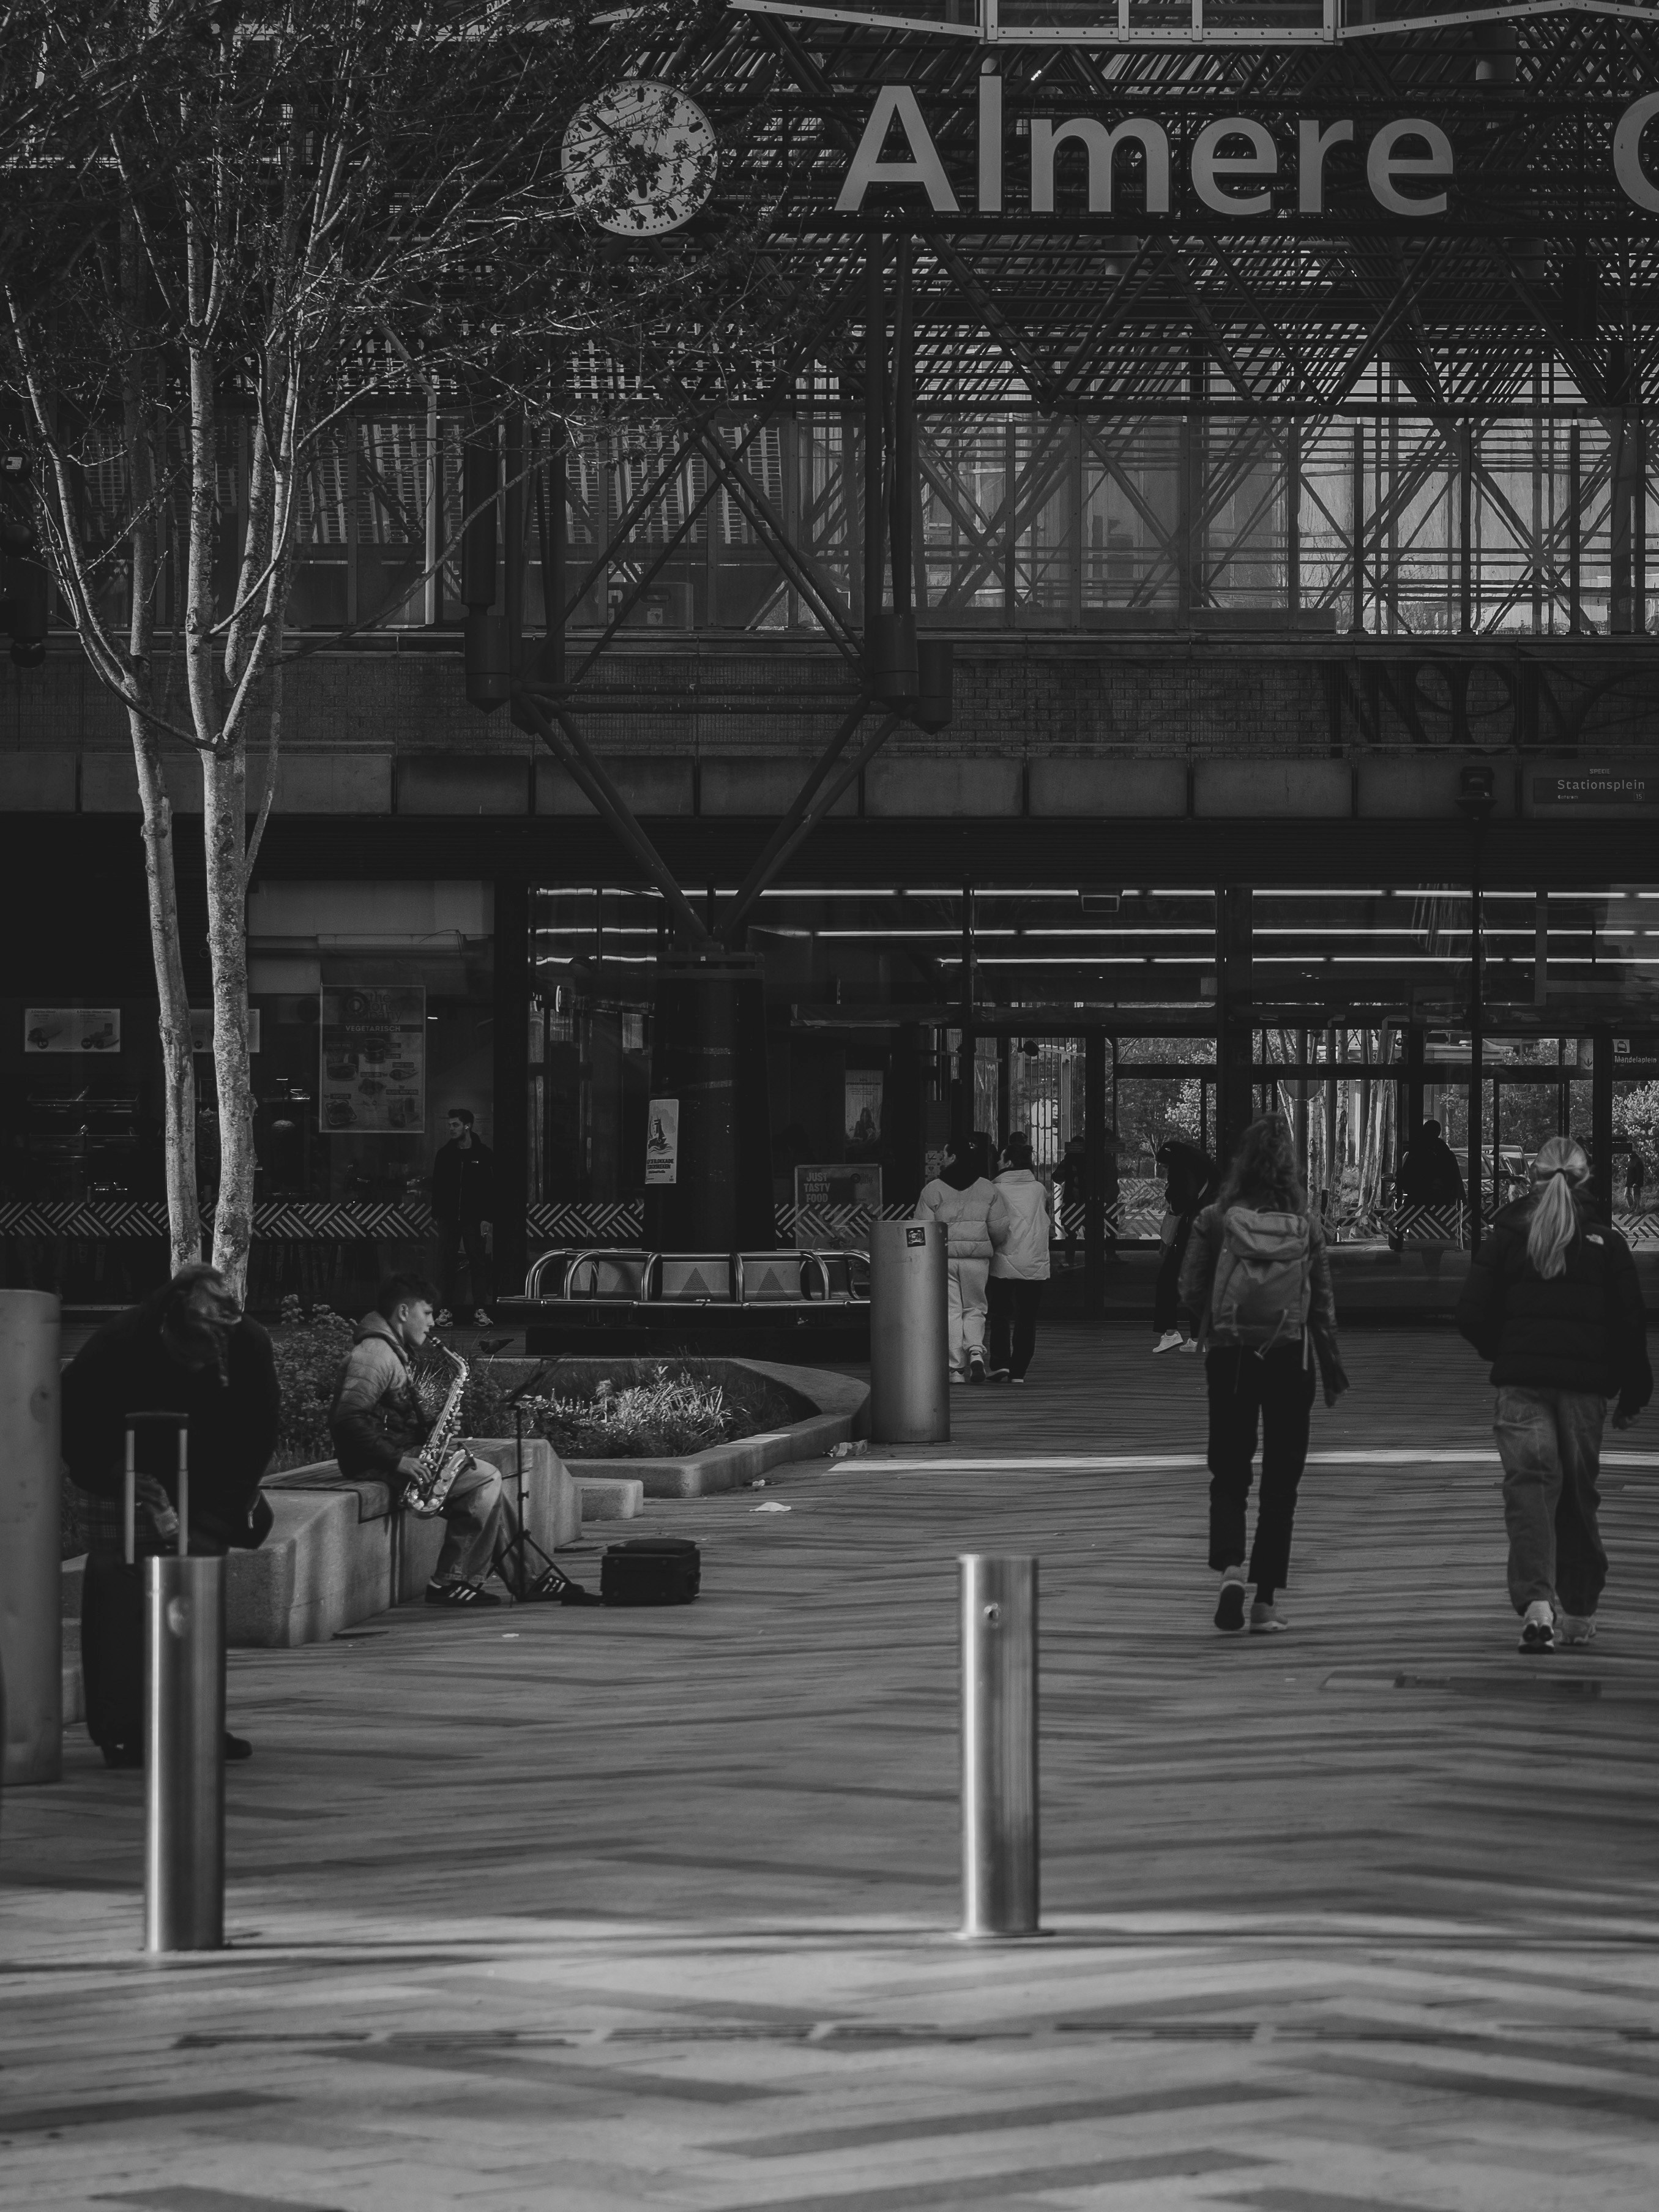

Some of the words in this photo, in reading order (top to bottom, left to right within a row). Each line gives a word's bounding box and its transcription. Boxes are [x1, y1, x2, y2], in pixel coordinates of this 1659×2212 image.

[833, 73, 1455, 217] Almere
[1557, 779, 1645, 791] Stationsplein
[1614, 1055, 1657, 1064] Mandelaplein
[806, 1172, 828, 1182] JUST
[803, 1183, 831, 1192] TASTY
[806, 1193, 829, 1203] FOOD
